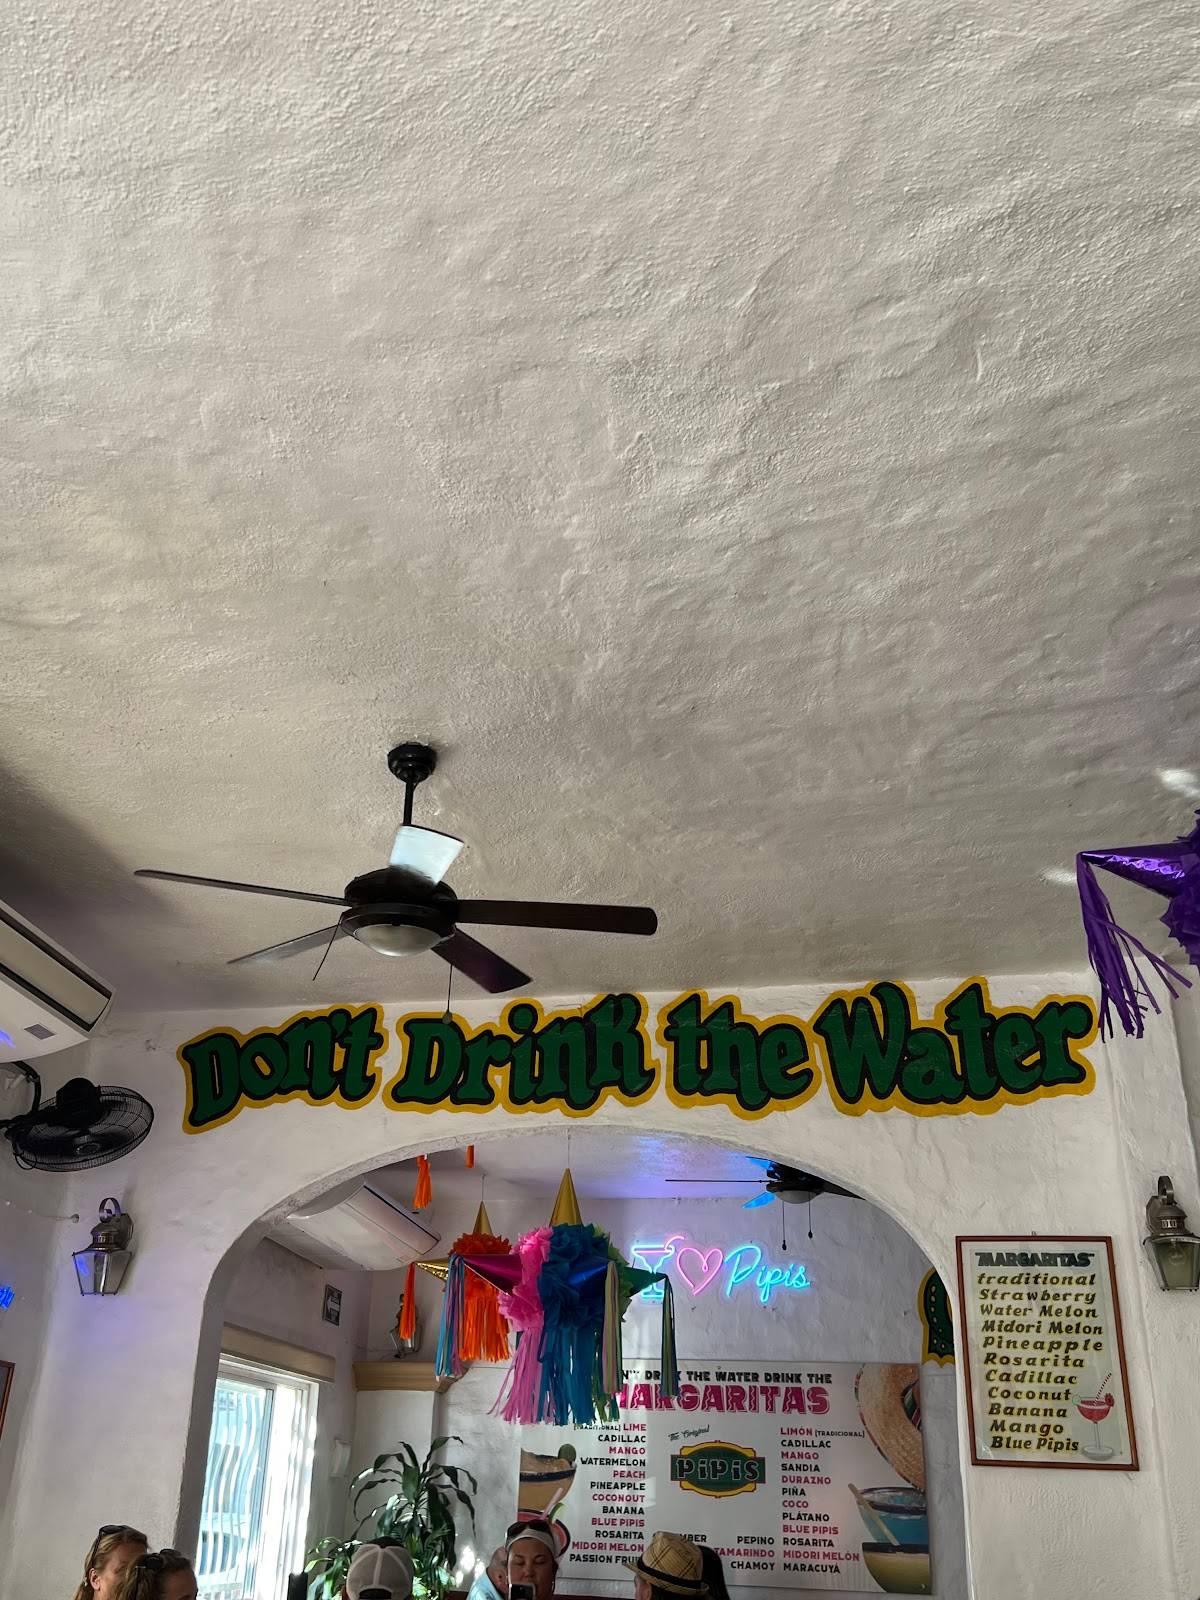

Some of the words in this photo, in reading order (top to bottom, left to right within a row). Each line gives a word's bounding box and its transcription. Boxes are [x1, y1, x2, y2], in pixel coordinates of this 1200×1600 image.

[179, 1006, 385, 1128] Don't
[390, 992, 657, 1111] Drink
[664, 993, 814, 1111] the
[812, 981, 1094, 1105] Water
[723, 1245, 811, 1303] Pipis
[977, 1273, 1096, 1285] traditional
[979, 1289, 1096, 1304] Strawberry
[980, 1304, 1033, 1316] Water
[1039, 1305, 1098, 1318] Melon
[981, 1320, 1042, 1333] Midori
[1048, 1321, 1103, 1335] Melon
[984, 1352, 1085, 1368] Rosarita
[686, 1371, 711, 1382] THE
[716, 1371, 759, 1383] WATER
[764, 1372, 802, 1384] DRINK
[807, 1373, 833, 1384] THE
[985, 1369, 1078, 1384] Cadillac
[988, 1387, 1072, 1401] Coconut
[988, 1403, 1068, 1417] Banana
[623, 1423, 647, 1431] LIME
[780, 1426, 813, 1436] LIMÓN
[990, 1420, 1064, 1436] Mango
[598, 1434, 647, 1443] CADILLAC
[781, 1440, 832, 1448] CADILLAC
[990, 1436, 1032, 1449] Blue
[1036, 1437, 1079, 1453] Pipis
[609, 1446, 646, 1455] MANGO
[781, 1451, 819, 1460] MANGO
[580, 1457, 646, 1467] WATERMELON
[613, 1470, 646, 1479] PEACH
[781, 1475, 831, 1485] DURAZNO
[590, 1481, 646, 1491] PINEAPPLE
[782, 1486, 806, 1496] PIÑA
[592, 1494, 646, 1503] COCONOUT
[782, 1500, 809, 1509] COCO
[602, 1506, 645, 1515] BANANA
[782, 1511, 830, 1522] PLÁTANO
[591, 1518, 618, 1526] BLUE
[619, 1518, 645, 1527] PIPIS
[595, 1530, 645, 1539] ROSARITA
[782, 1524, 810, 1534] BLUE
[812, 1526, 839, 1535] PIPIS
[737, 1535, 775, 1545] PEPINO
[783, 1537, 835, 1547] ROSARITA
[572, 1541, 607, 1550] MIDORI
[609, 1542, 644, 1552] MELON
[714, 1548, 775, 1557] TAMARINDO
[783, 1550, 820, 1560] MIDORI
[569, 1553, 612, 1563] PASSION
[730, 1561, 775, 1571] CHAMOY
[783, 1562, 841, 1573] MARACUYÁ
